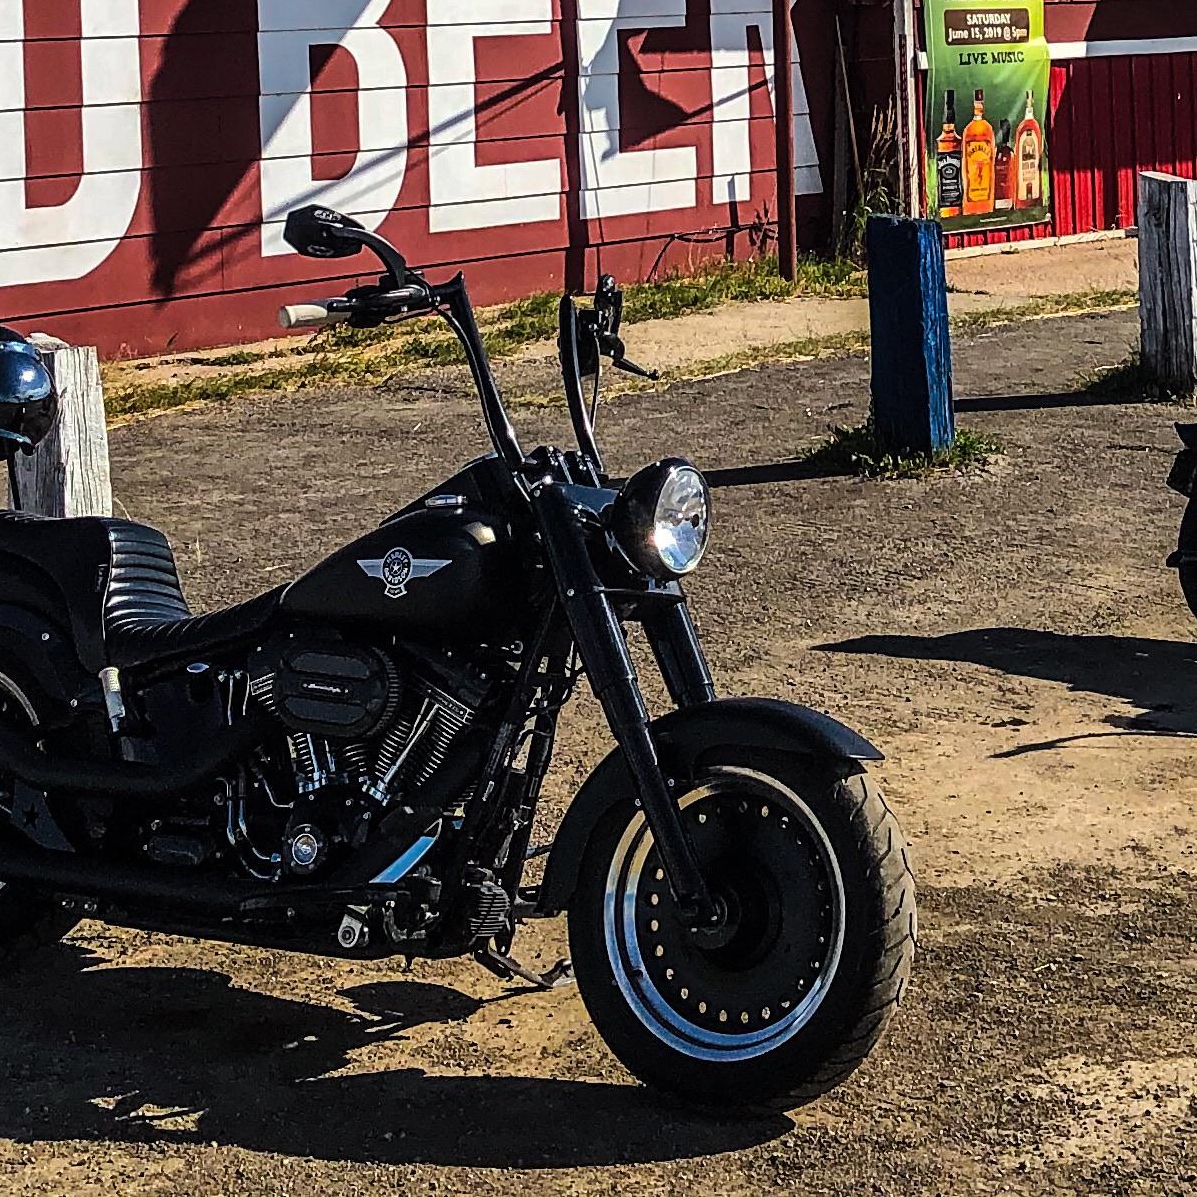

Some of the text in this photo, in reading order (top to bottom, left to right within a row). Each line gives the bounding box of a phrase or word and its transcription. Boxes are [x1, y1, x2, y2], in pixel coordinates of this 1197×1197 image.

[966, 13, 1011, 25] SATURDAY
[947, 27, 969, 42] June
[984, 26, 1002, 38] 2019
[1011, 25, 1028, 41] 5pm
[958, 51, 1025, 66] LIVE MUSIC
